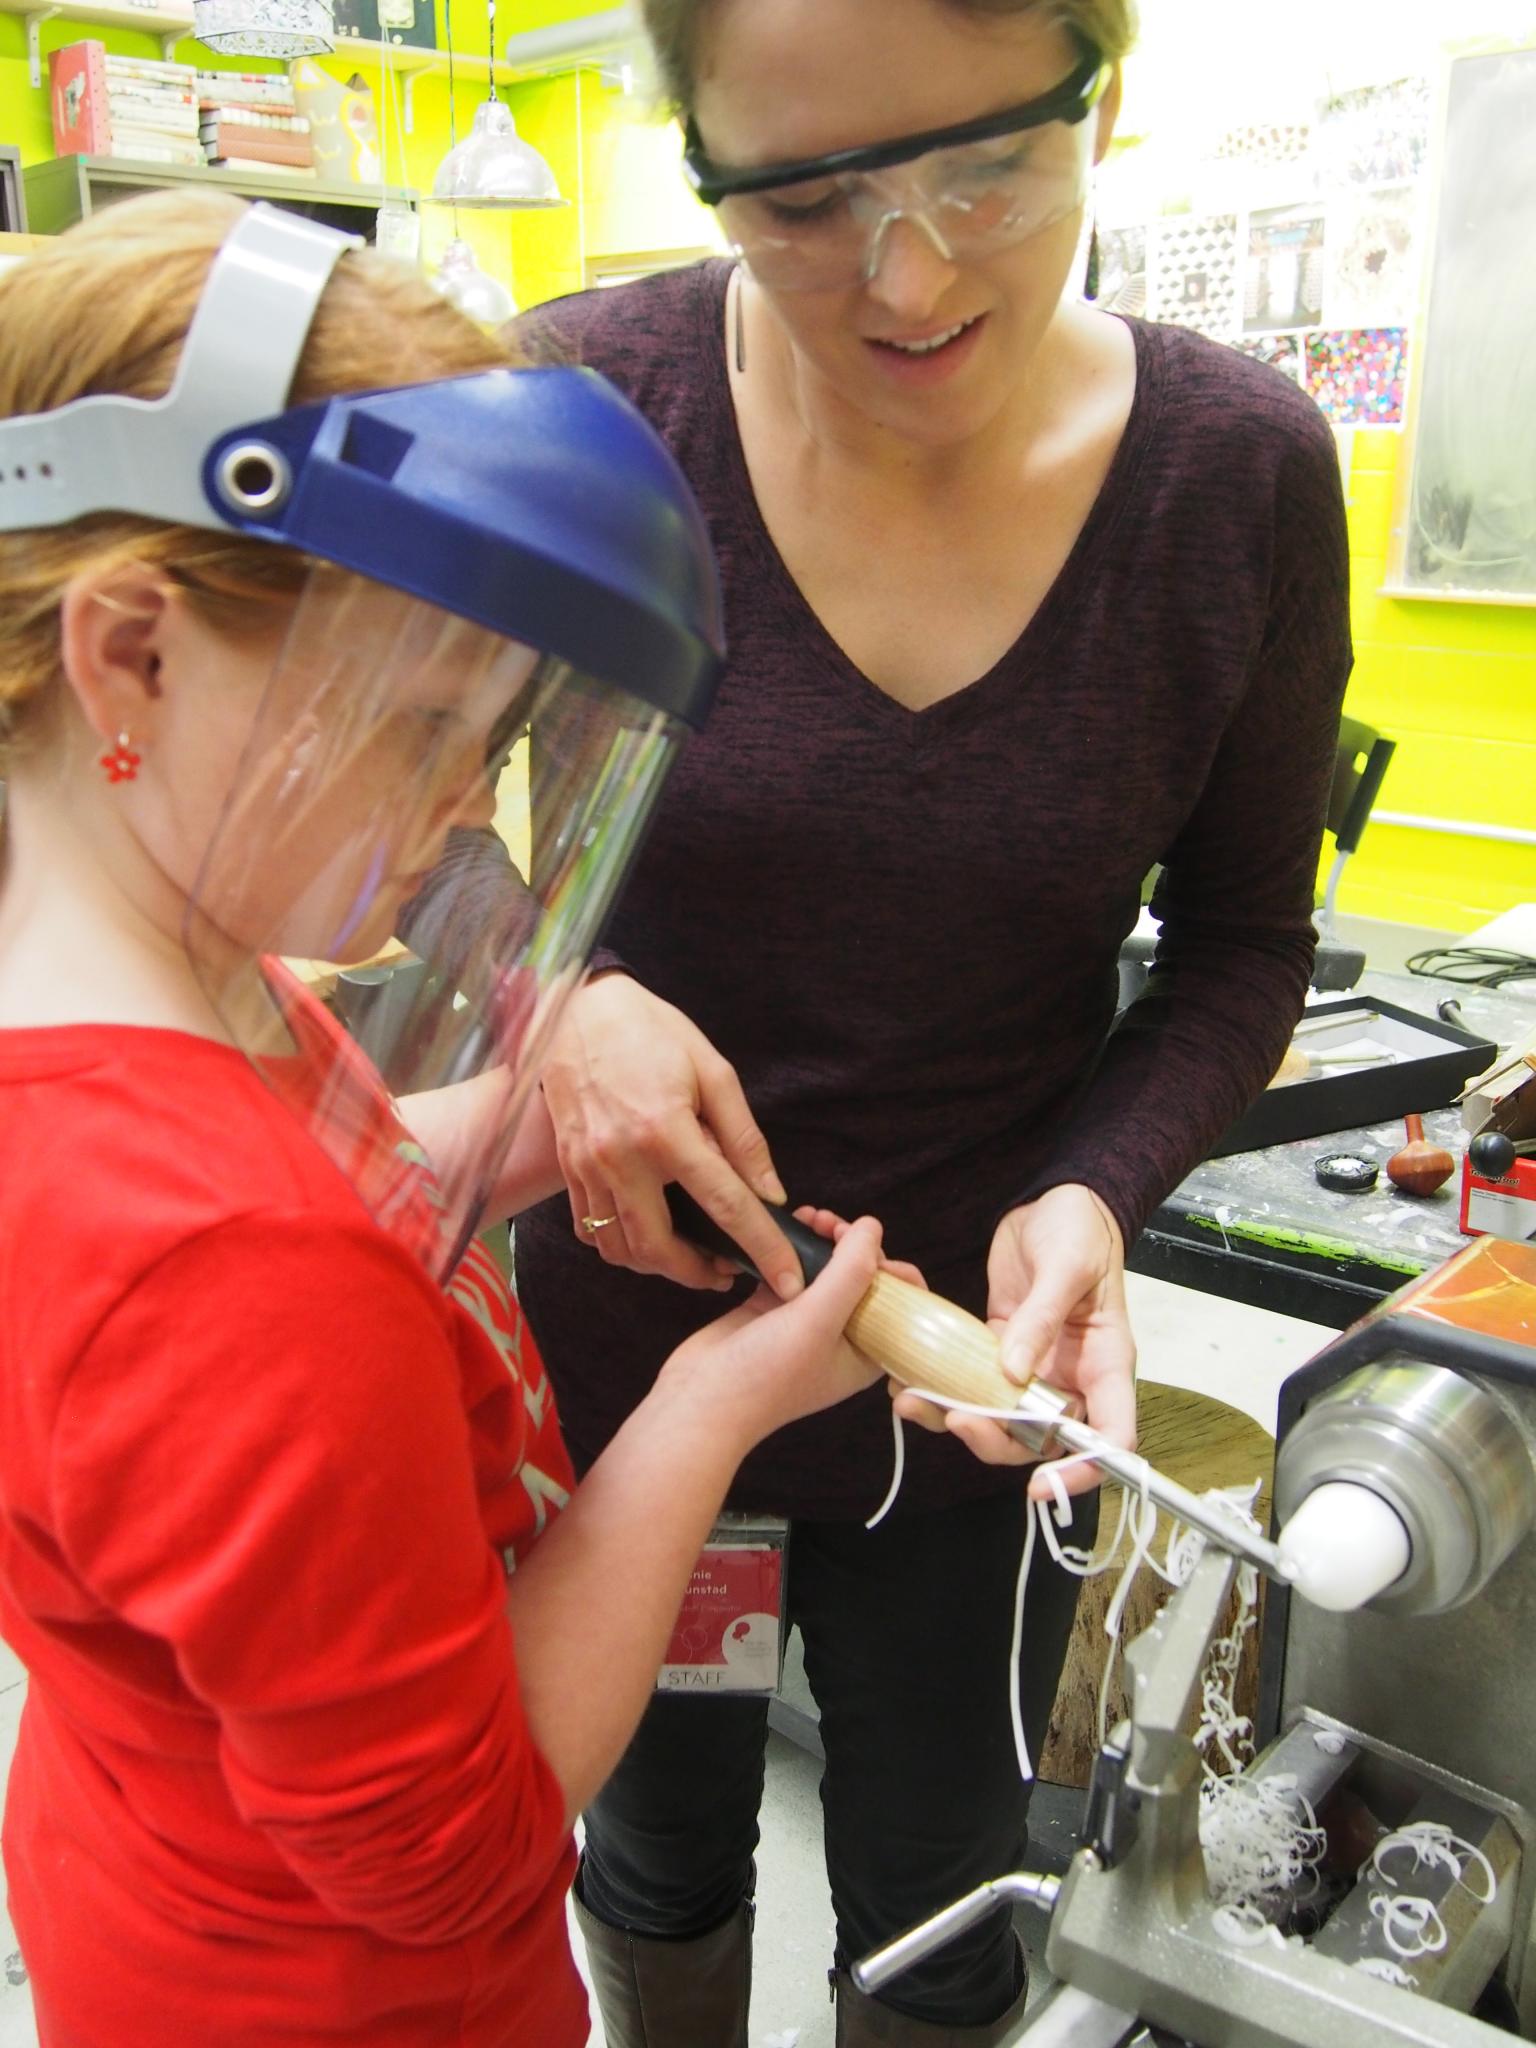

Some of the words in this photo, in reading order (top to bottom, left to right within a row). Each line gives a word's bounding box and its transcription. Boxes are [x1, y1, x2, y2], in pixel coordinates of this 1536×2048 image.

[690, 1570, 712, 1580] nie
[685, 1584, 727, 1595] unstad
[668, 1671, 726, 1685] STAFF
